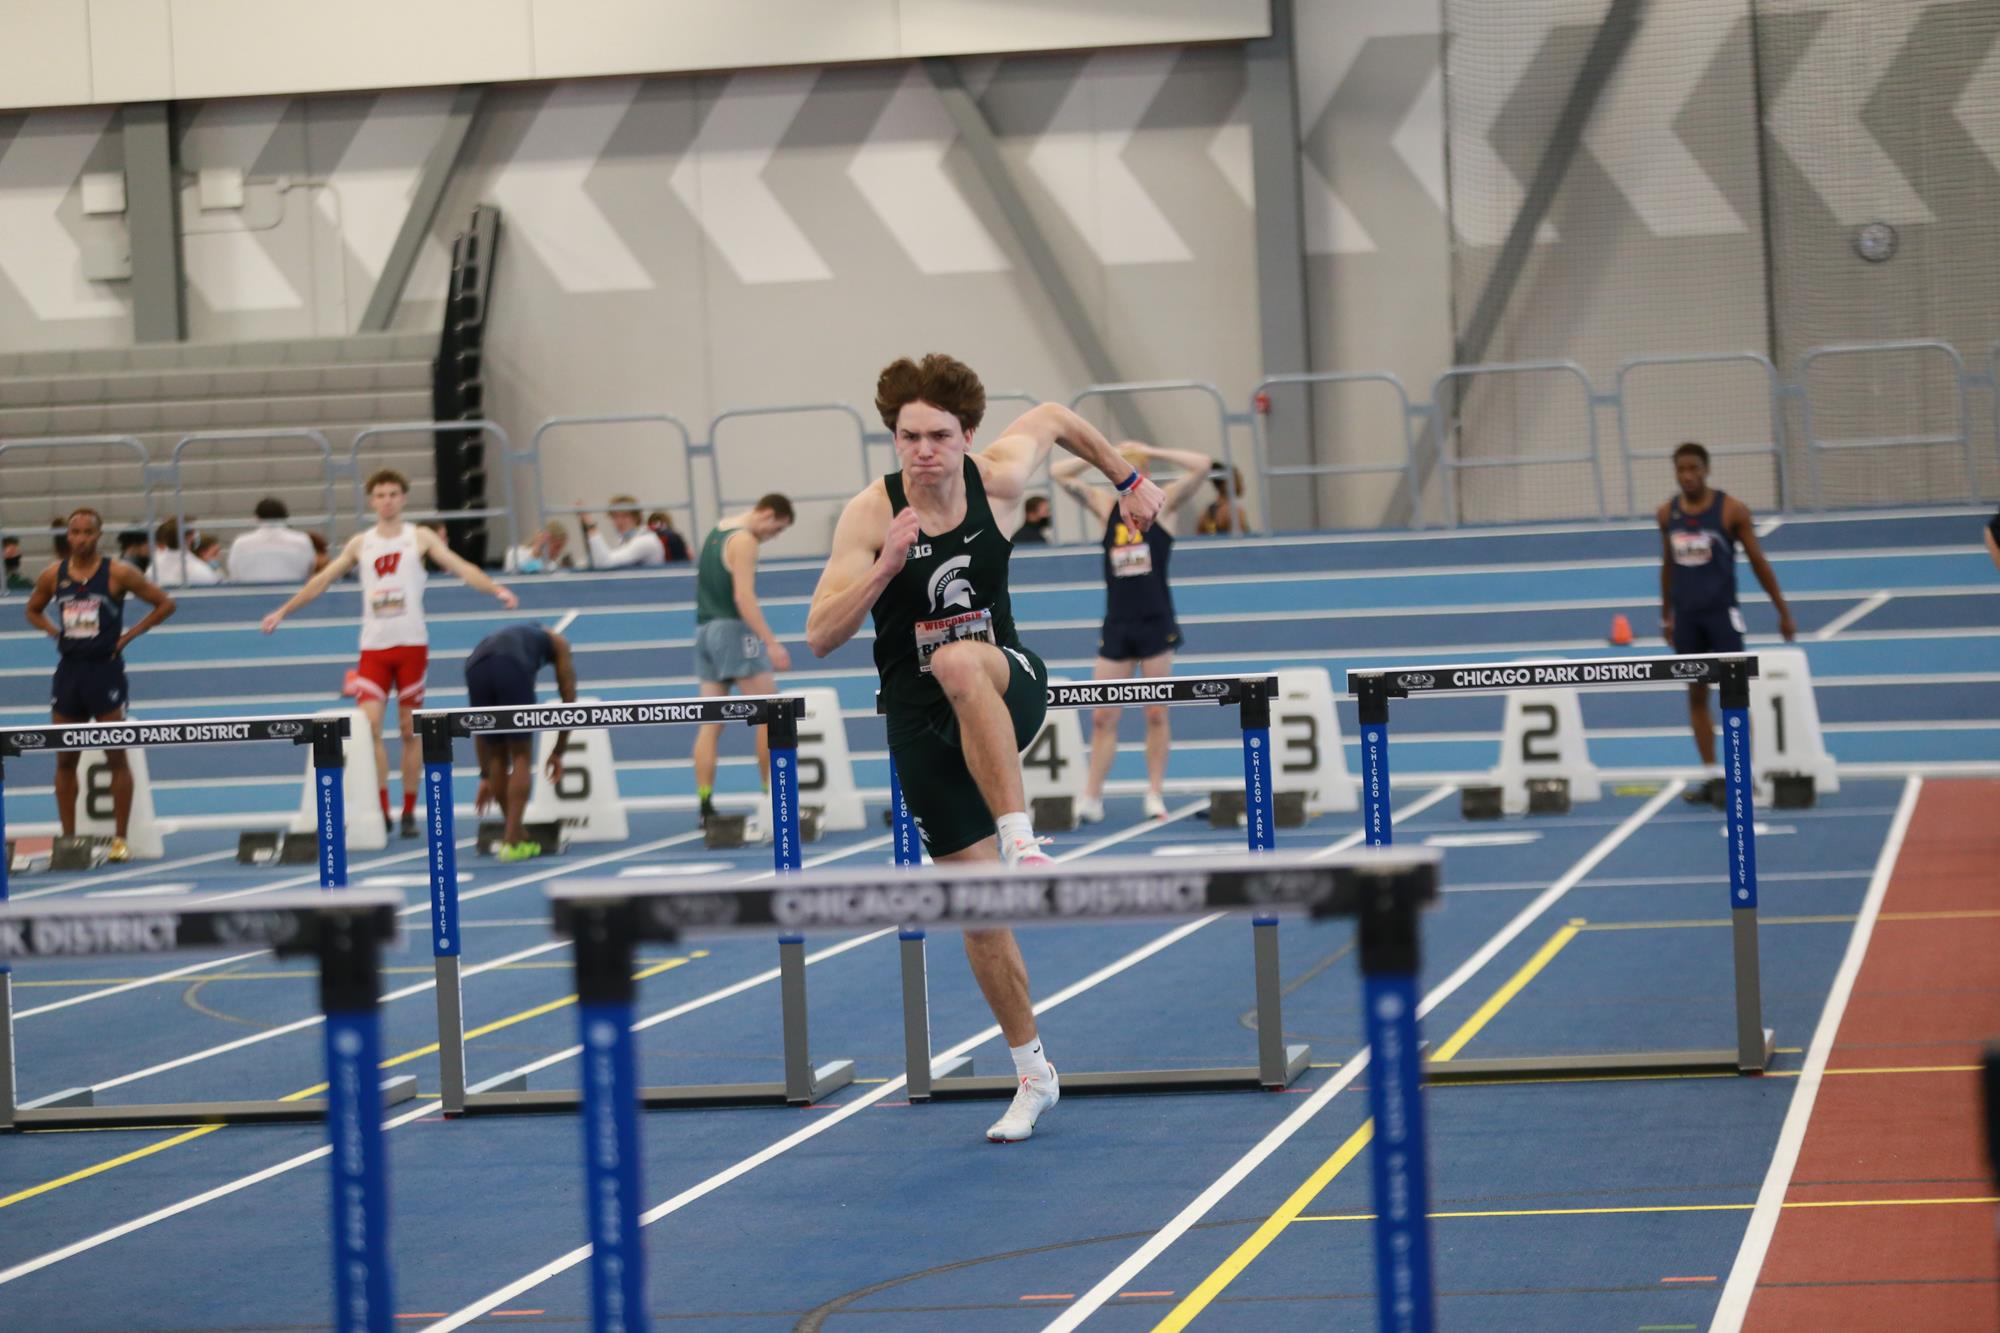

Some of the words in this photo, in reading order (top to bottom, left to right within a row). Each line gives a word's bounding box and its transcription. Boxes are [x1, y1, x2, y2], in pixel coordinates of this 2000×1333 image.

[924, 611, 982, 631] WISCONSIN
[1060, 687, 1103, 703] PARK
[1107, 683, 1174, 702] DISTRICT
[1452, 669, 1531, 687] CHICAGO
[1534, 666, 1579, 683] PARK
[1583, 663, 1653, 681] DISTRICT
[62, 728, 136, 746] CHICAGO
[139, 726, 182, 743] PARK
[185, 724, 250, 741] DISTRICT
[513, 710, 587, 728] CHICAGO
[591, 708, 634, 725] PARK
[638, 704, 703, 722] DISTRICT
[1521, 704, 1560, 762] 2
[1771, 695, 1786, 754] 1
[1022, 723, 1068, 782] 4
[1281, 715, 1319, 773] 3
[1732, 731, 1741, 783] CHICAGO
[555, 743, 591, 801] 6
[779, 771, 788, 822] CHICAGO
[1252, 751, 1262, 803] CHICAGO
[1370, 746, 1379, 798] CHICAGO
[324, 788, 333, 840] CHICAGO
[433, 785, 442, 836] CHICAGO
[1735, 789, 1743, 819] PARK
[436, 842, 444, 870] PARK
[1737, 825, 1746, 885] DISTRICT
[438, 876, 446, 934] DISTRICT
